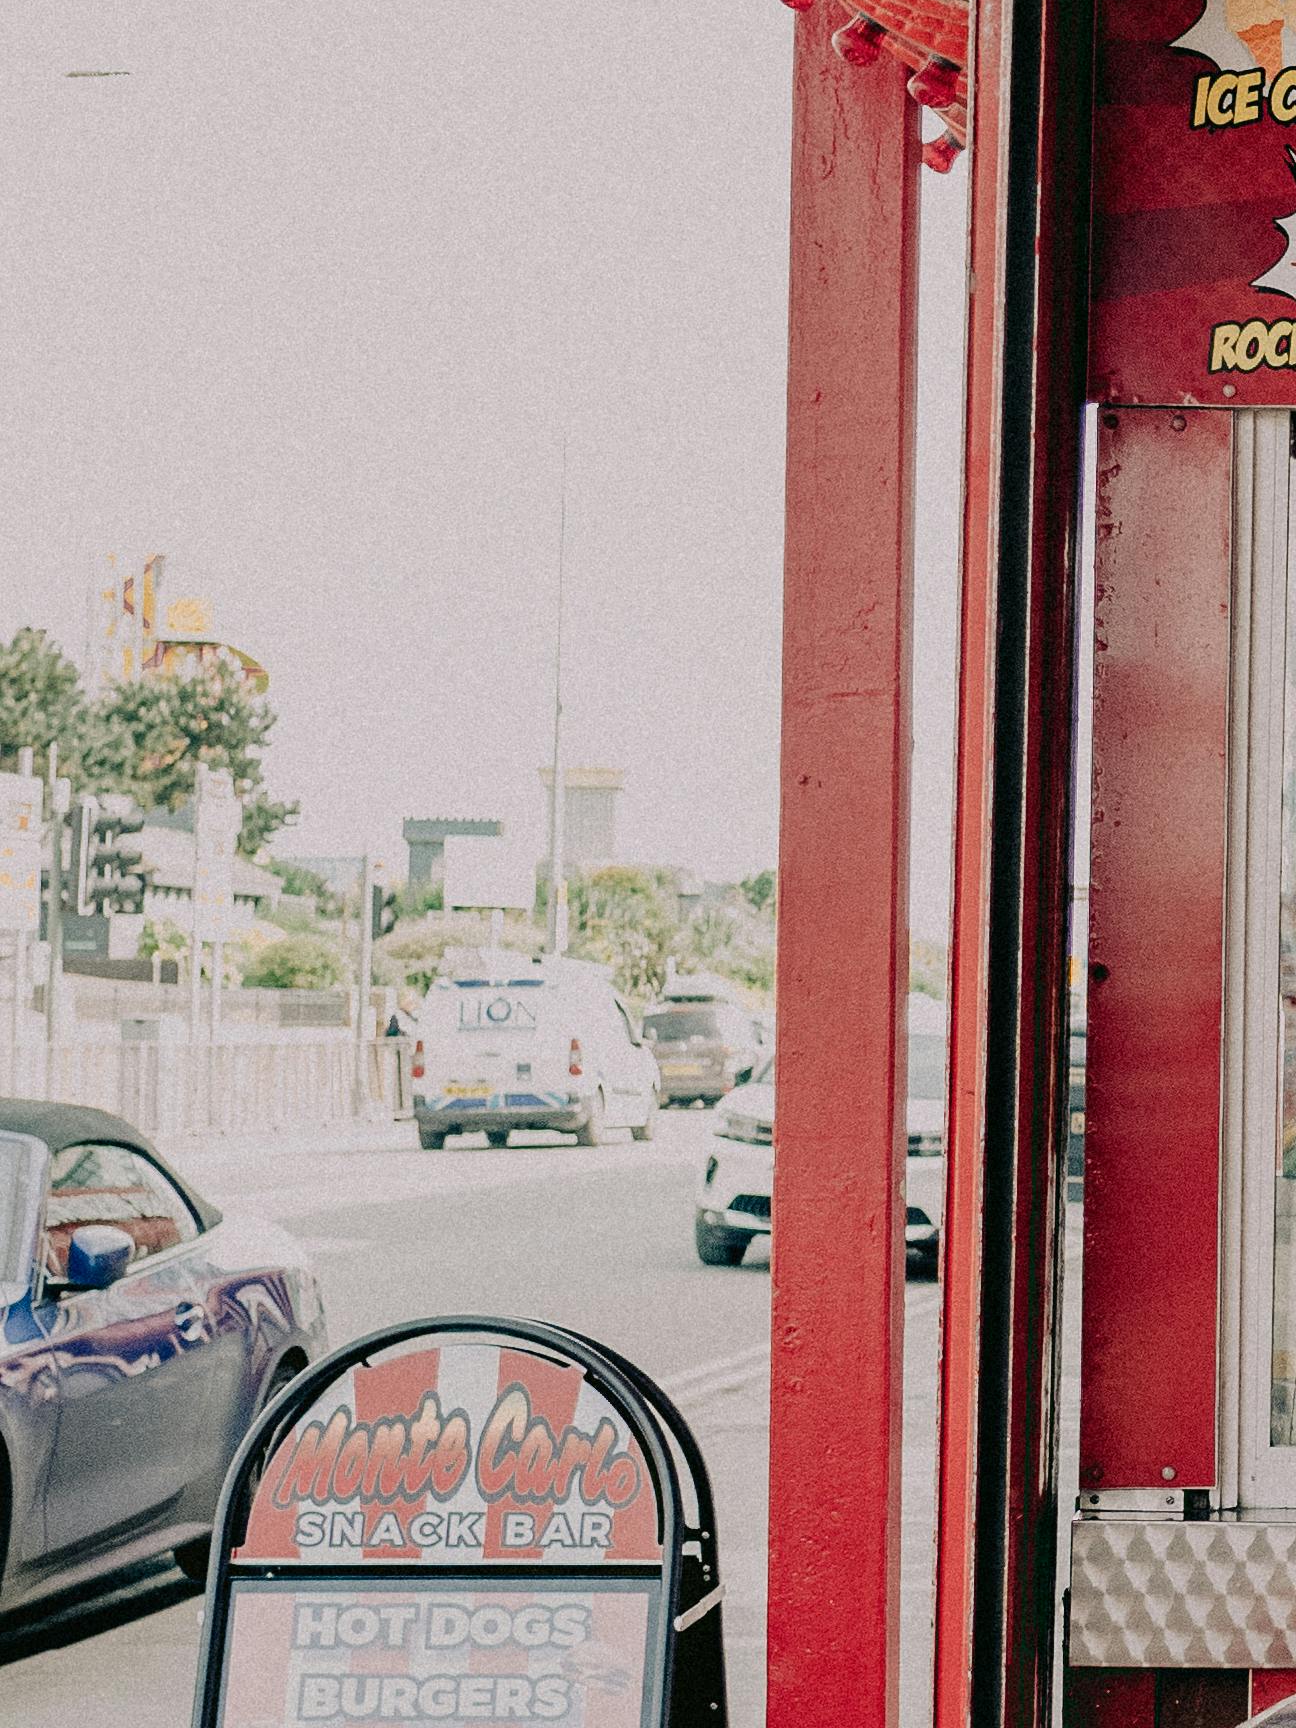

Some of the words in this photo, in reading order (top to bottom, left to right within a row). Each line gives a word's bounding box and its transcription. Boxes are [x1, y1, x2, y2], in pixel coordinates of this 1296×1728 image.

[1192, 68, 1266, 129] ICE
[274, 1390, 469, 1512] Monte
[476, 1382, 644, 1510] Carlo
[295, 1510, 483, 1549] SNACK
[502, 1511, 614, 1549] BAR
[296, 1607, 421, 1652] HOT
[428, 1604, 591, 1651] DOGS
[297, 1676, 572, 1722] BURGERS
